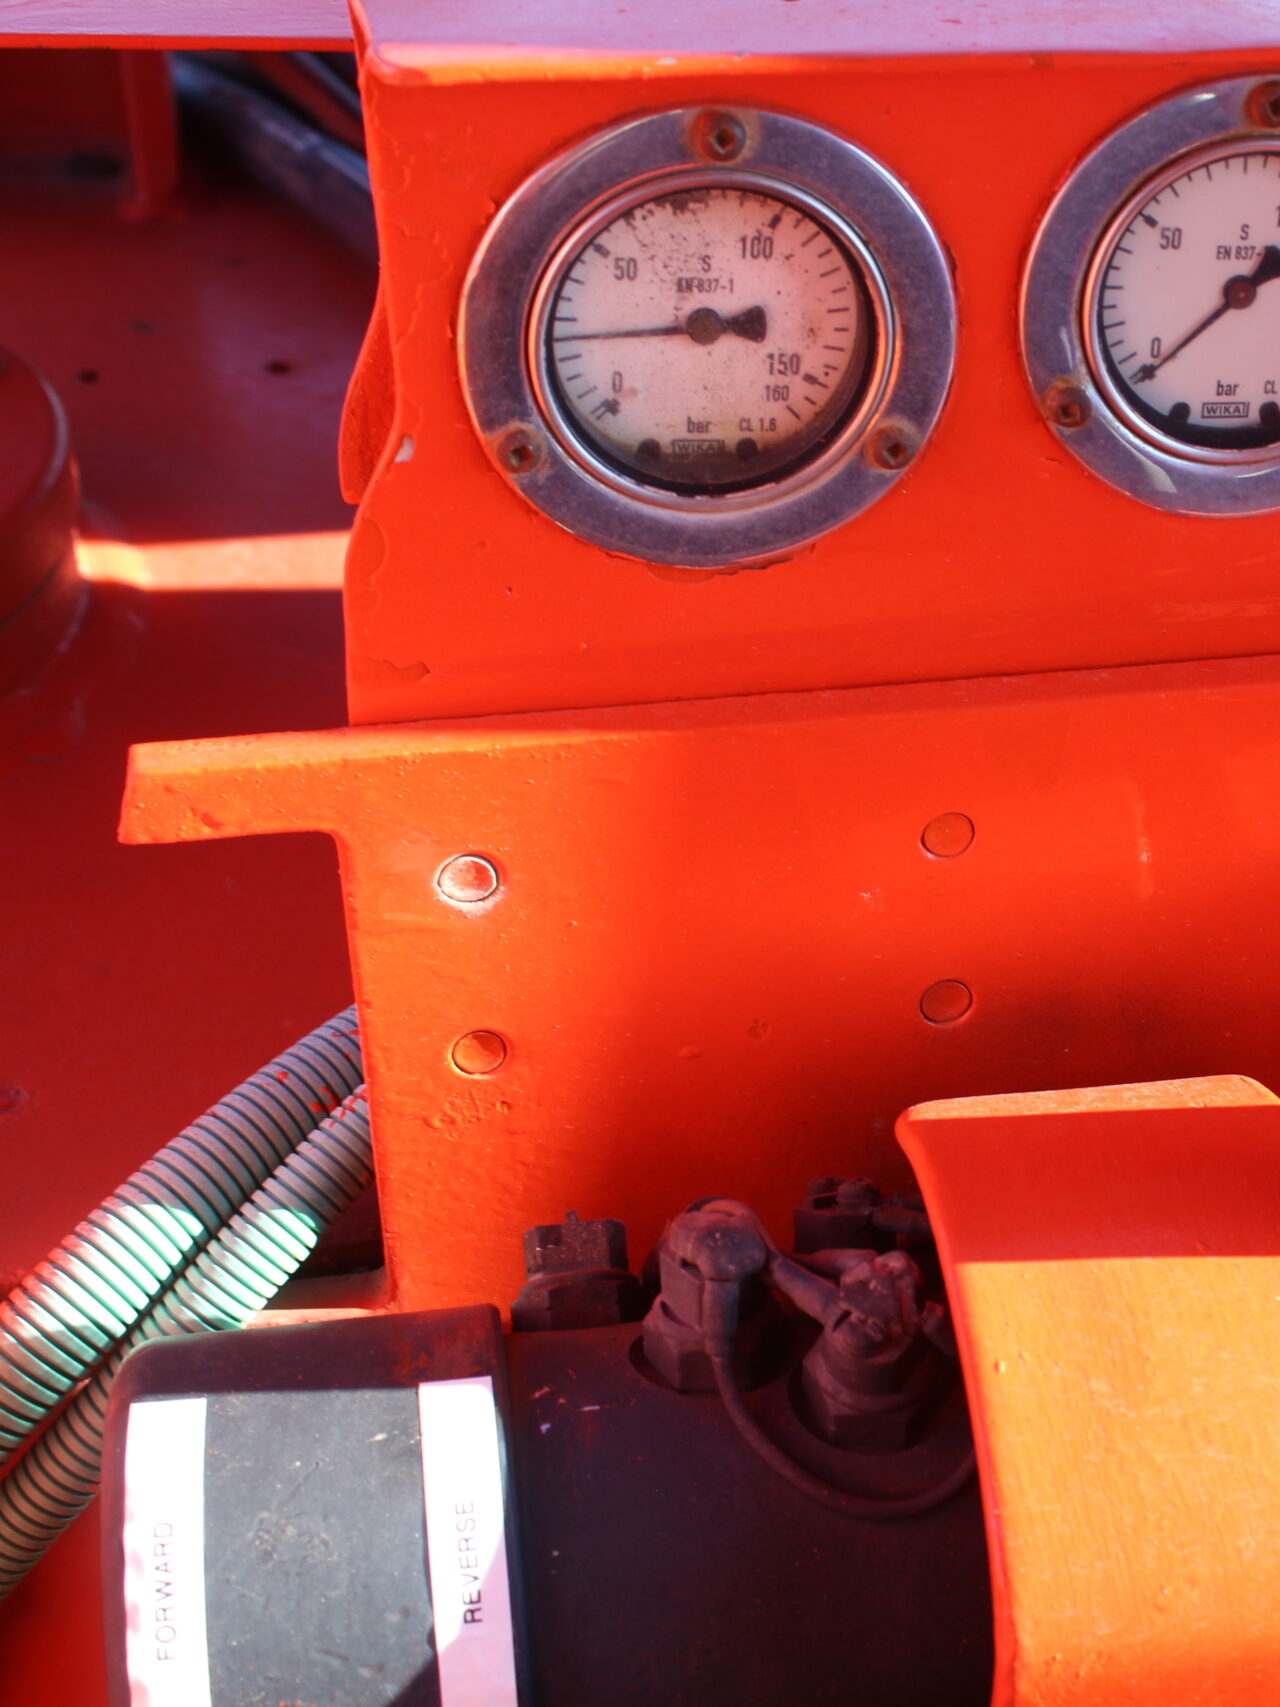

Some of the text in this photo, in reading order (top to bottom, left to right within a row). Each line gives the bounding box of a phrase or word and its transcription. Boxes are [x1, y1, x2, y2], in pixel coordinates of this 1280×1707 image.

[1160, 227, 1183, 250] 50
[1240, 224, 1250, 241] S
[739, 235, 774, 259] 100
[1216, 247, 1232, 261] EN
[613, 257, 638, 281] 50
[701, 254, 712, 273] S
[1151, 337, 1162, 360] 0
[766, 353, 800, 376] 150
[612, 370, 623, 394] 0
[1216, 380, 1239, 396] bar
[1264, 381, 1278, 395] CL
[764, 385, 789, 403] 160
[1205, 404, 1242, 416] WIKA
[686, 416, 712, 433] bar
[738, 417, 777, 432] CL 1.6
[454, 1500, 483, 1625] REVERSE
[153, 1521, 177, 1662] FORWARD
